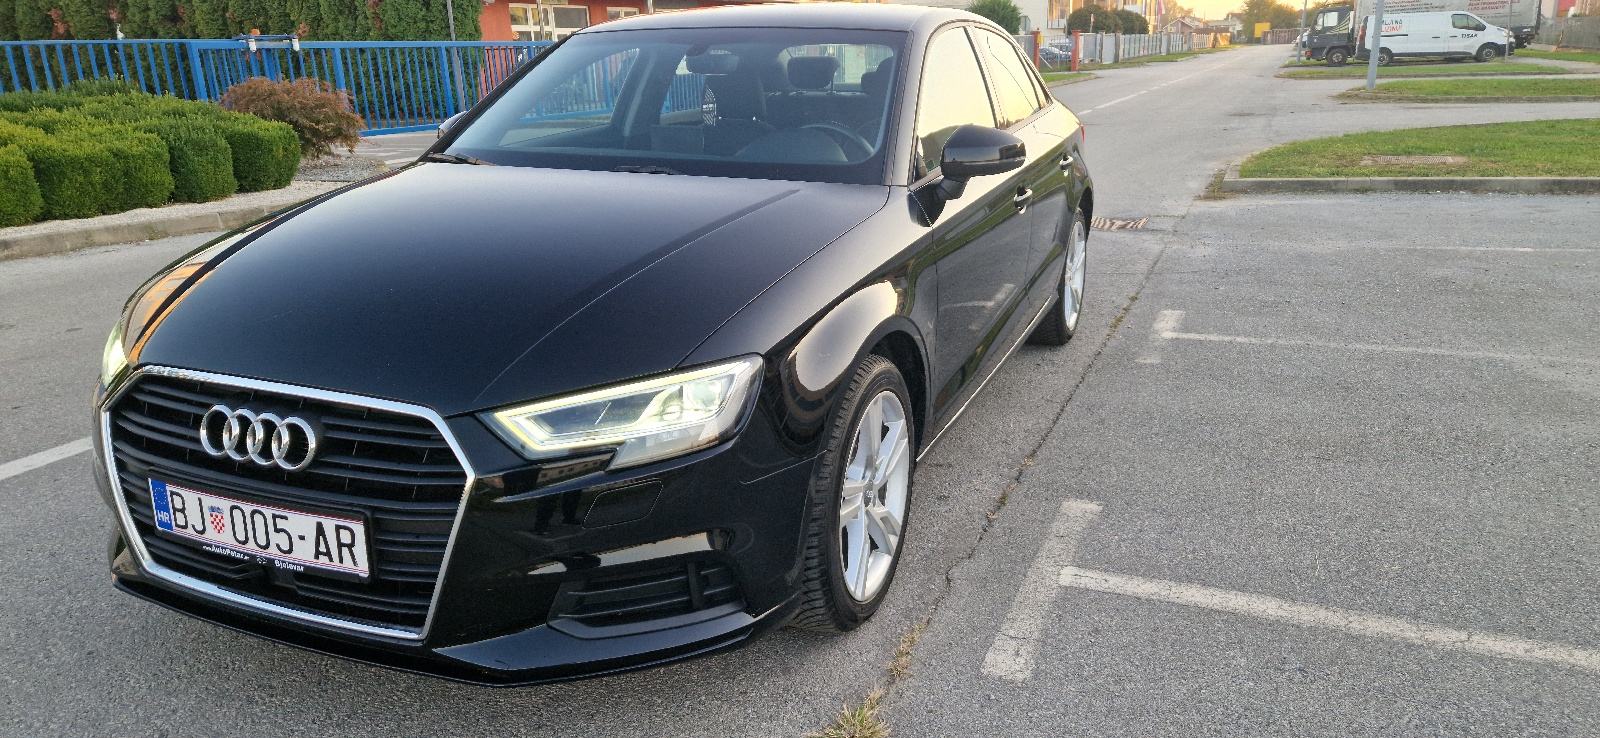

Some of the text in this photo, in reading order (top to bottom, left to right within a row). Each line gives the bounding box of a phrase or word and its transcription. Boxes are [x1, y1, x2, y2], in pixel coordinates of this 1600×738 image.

[156, 510, 171, 524] HR
[169, 490, 359, 567] BJ 005-AR
